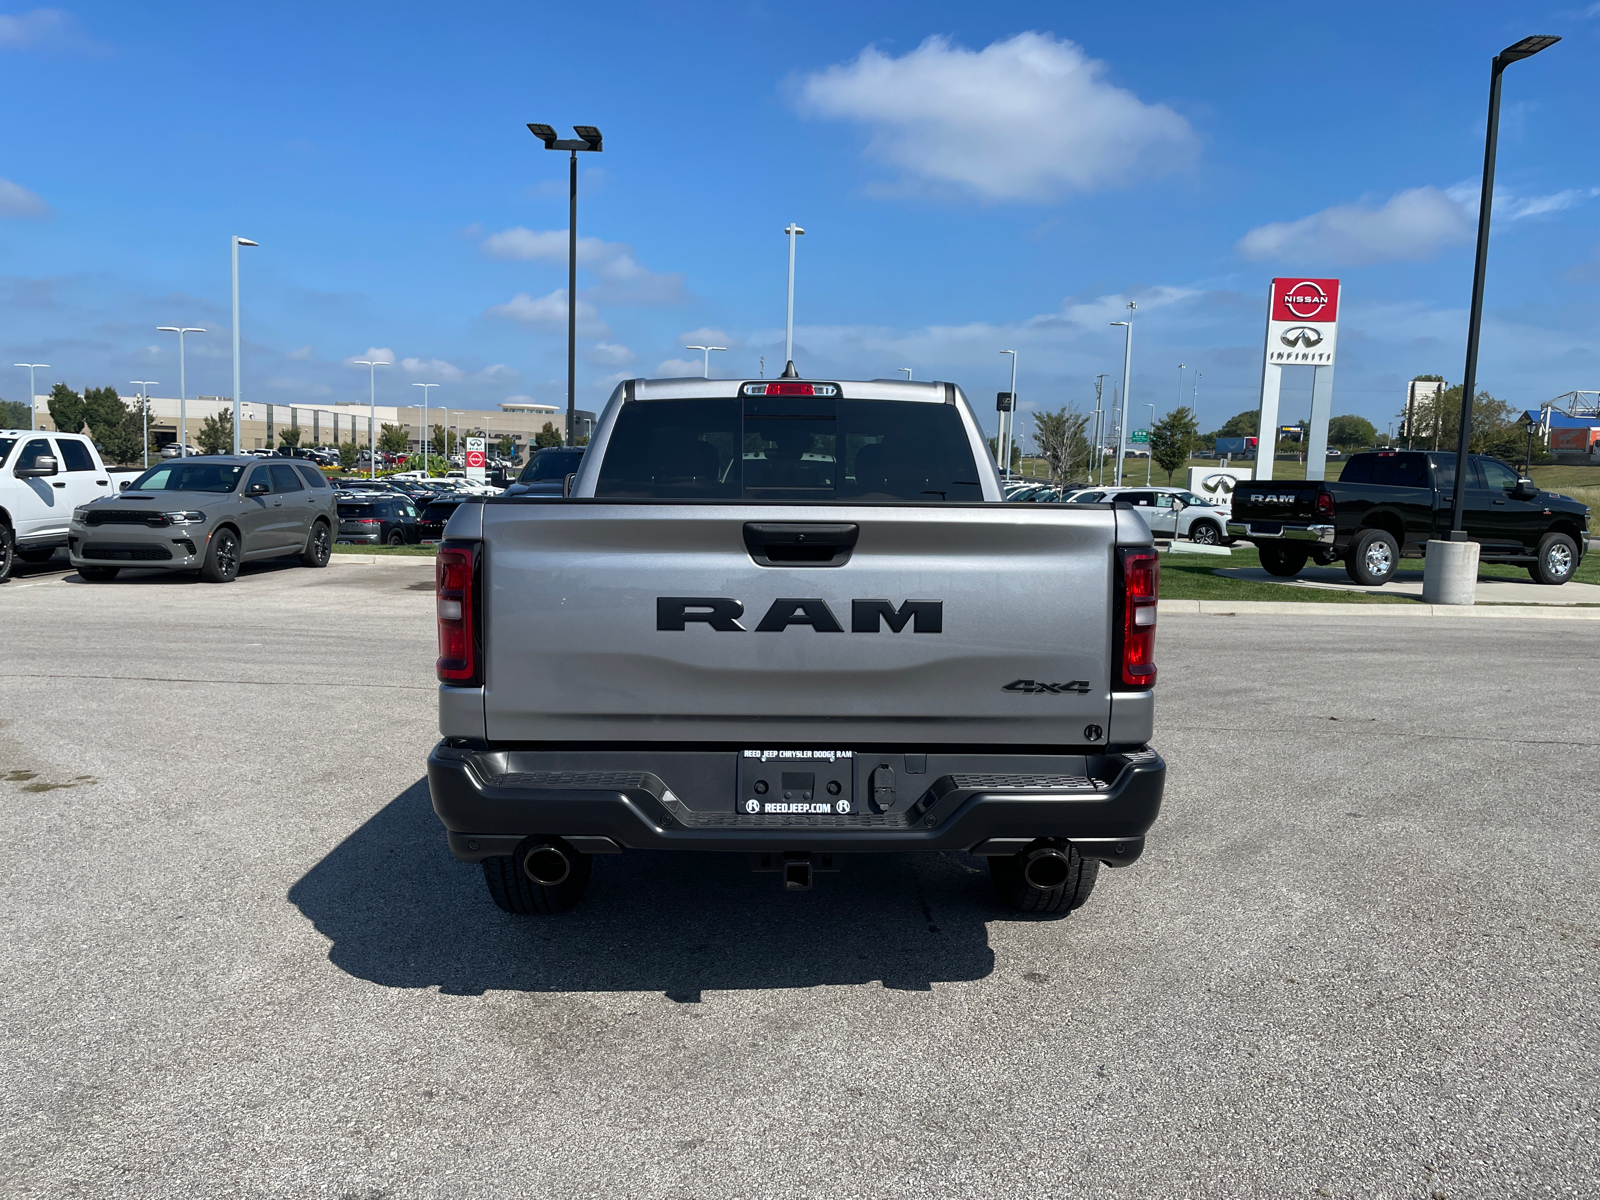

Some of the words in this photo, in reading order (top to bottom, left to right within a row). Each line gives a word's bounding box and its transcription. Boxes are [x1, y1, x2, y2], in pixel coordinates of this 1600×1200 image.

[1284, 295, 1328, 304] NISSAN
[1270, 351, 1331, 362] INFINITI
[1250, 494, 1295, 503] RAM
[656, 596, 943, 633] RAM
[1002, 679, 1092, 694] 4x4
[744, 750, 761, 758] REED
[762, 750, 778, 758] JEEP
[765, 803, 831, 813] REEDJEEP.COM
